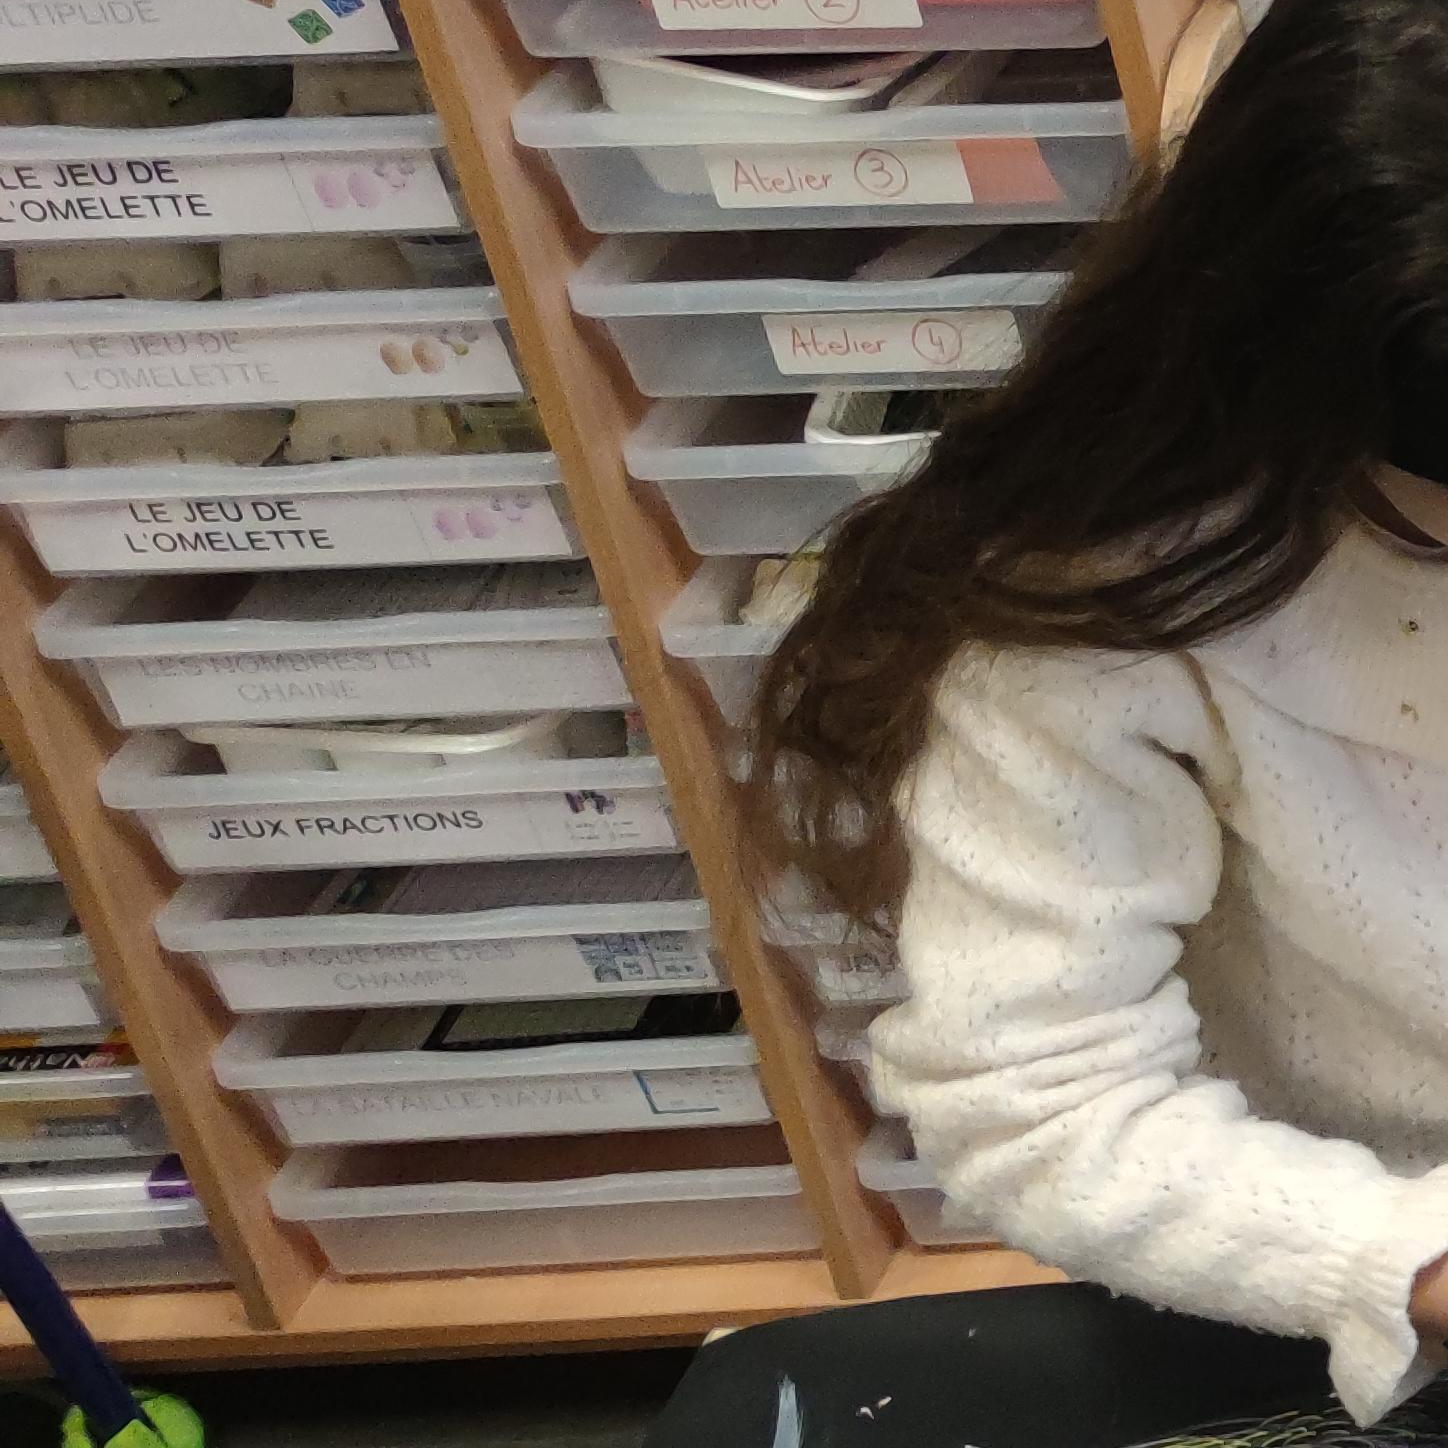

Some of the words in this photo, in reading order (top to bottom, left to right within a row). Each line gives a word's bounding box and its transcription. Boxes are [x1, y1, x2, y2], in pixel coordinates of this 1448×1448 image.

[0, 166, 42, 191] LE
[53, 162, 118, 188] JEU
[126, 160, 180, 185] DE
[732, 160, 834, 194] Atelier
[0, 193, 213, 223] L'OMELETTE
[790, 328, 887, 358] Atelier
[128, 502, 174, 524] LE
[183, 501, 244, 524] JEU
[250, 500, 303, 522] DE
[124, 528, 336, 553] L'OMELETTE
[208, 818, 290, 841] JEUX
[294, 810, 485, 838] FRACTIONS
